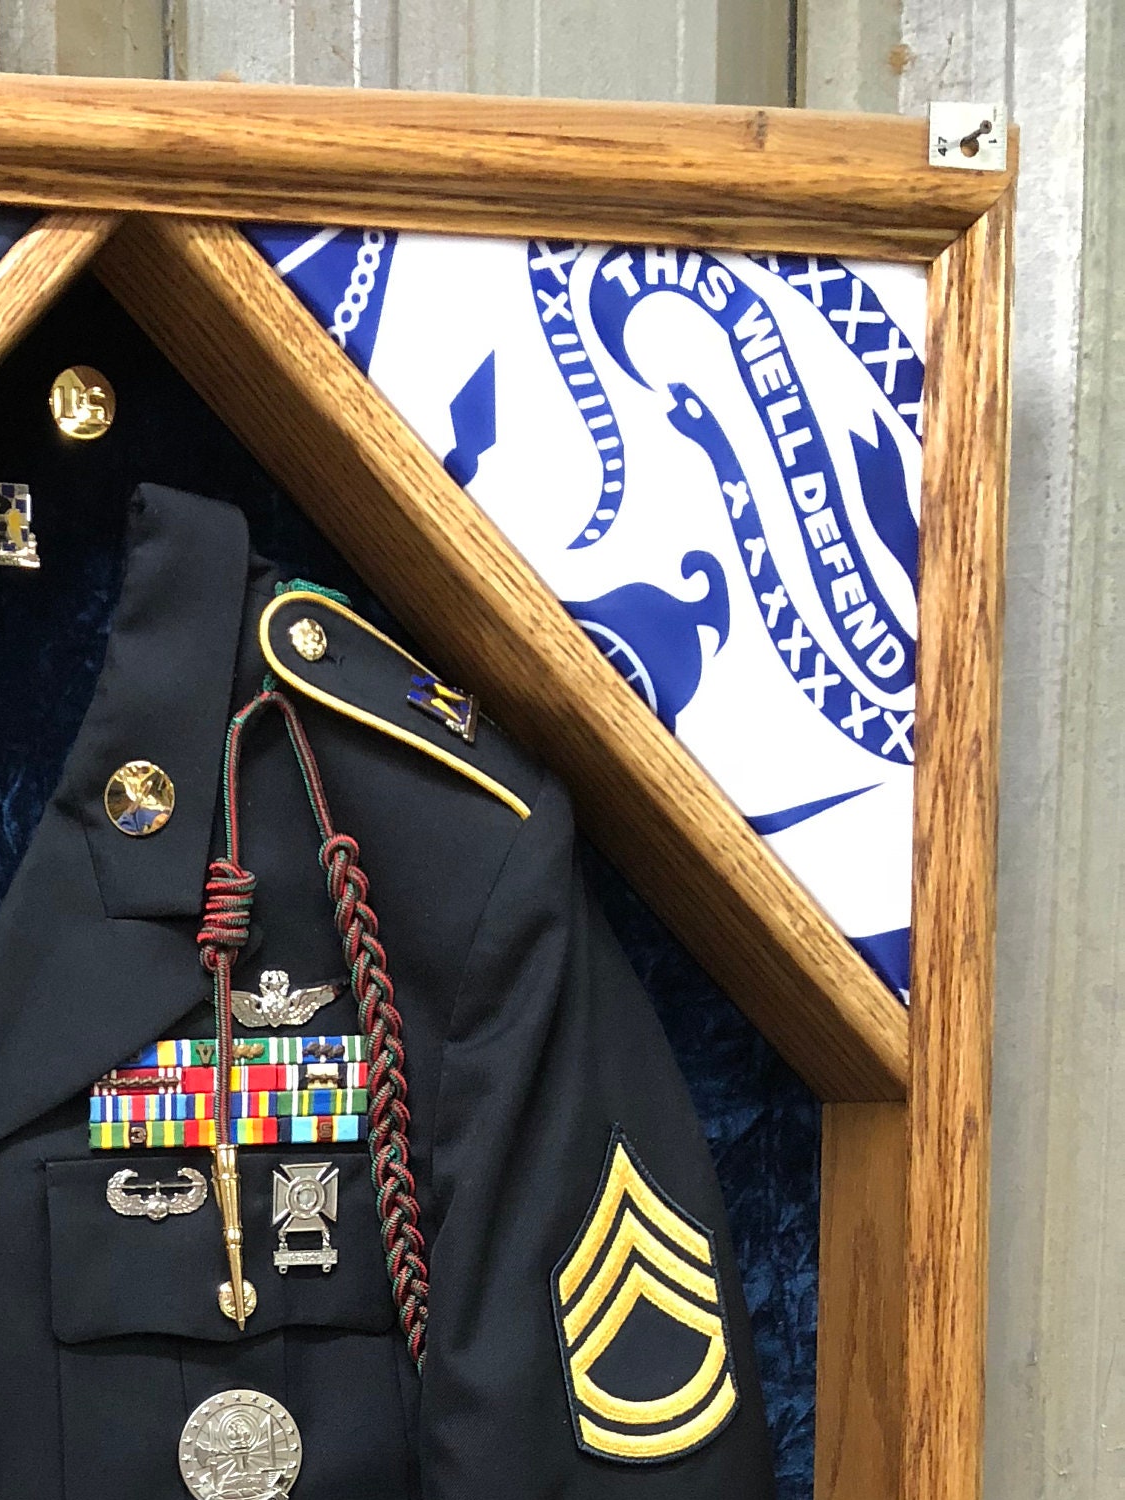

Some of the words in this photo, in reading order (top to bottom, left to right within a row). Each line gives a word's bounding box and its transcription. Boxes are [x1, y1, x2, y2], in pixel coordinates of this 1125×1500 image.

[601, 244, 736, 311] THIS
[733, 301, 813, 468] WE'LL
[790, 470, 906, 679] DEFEND
